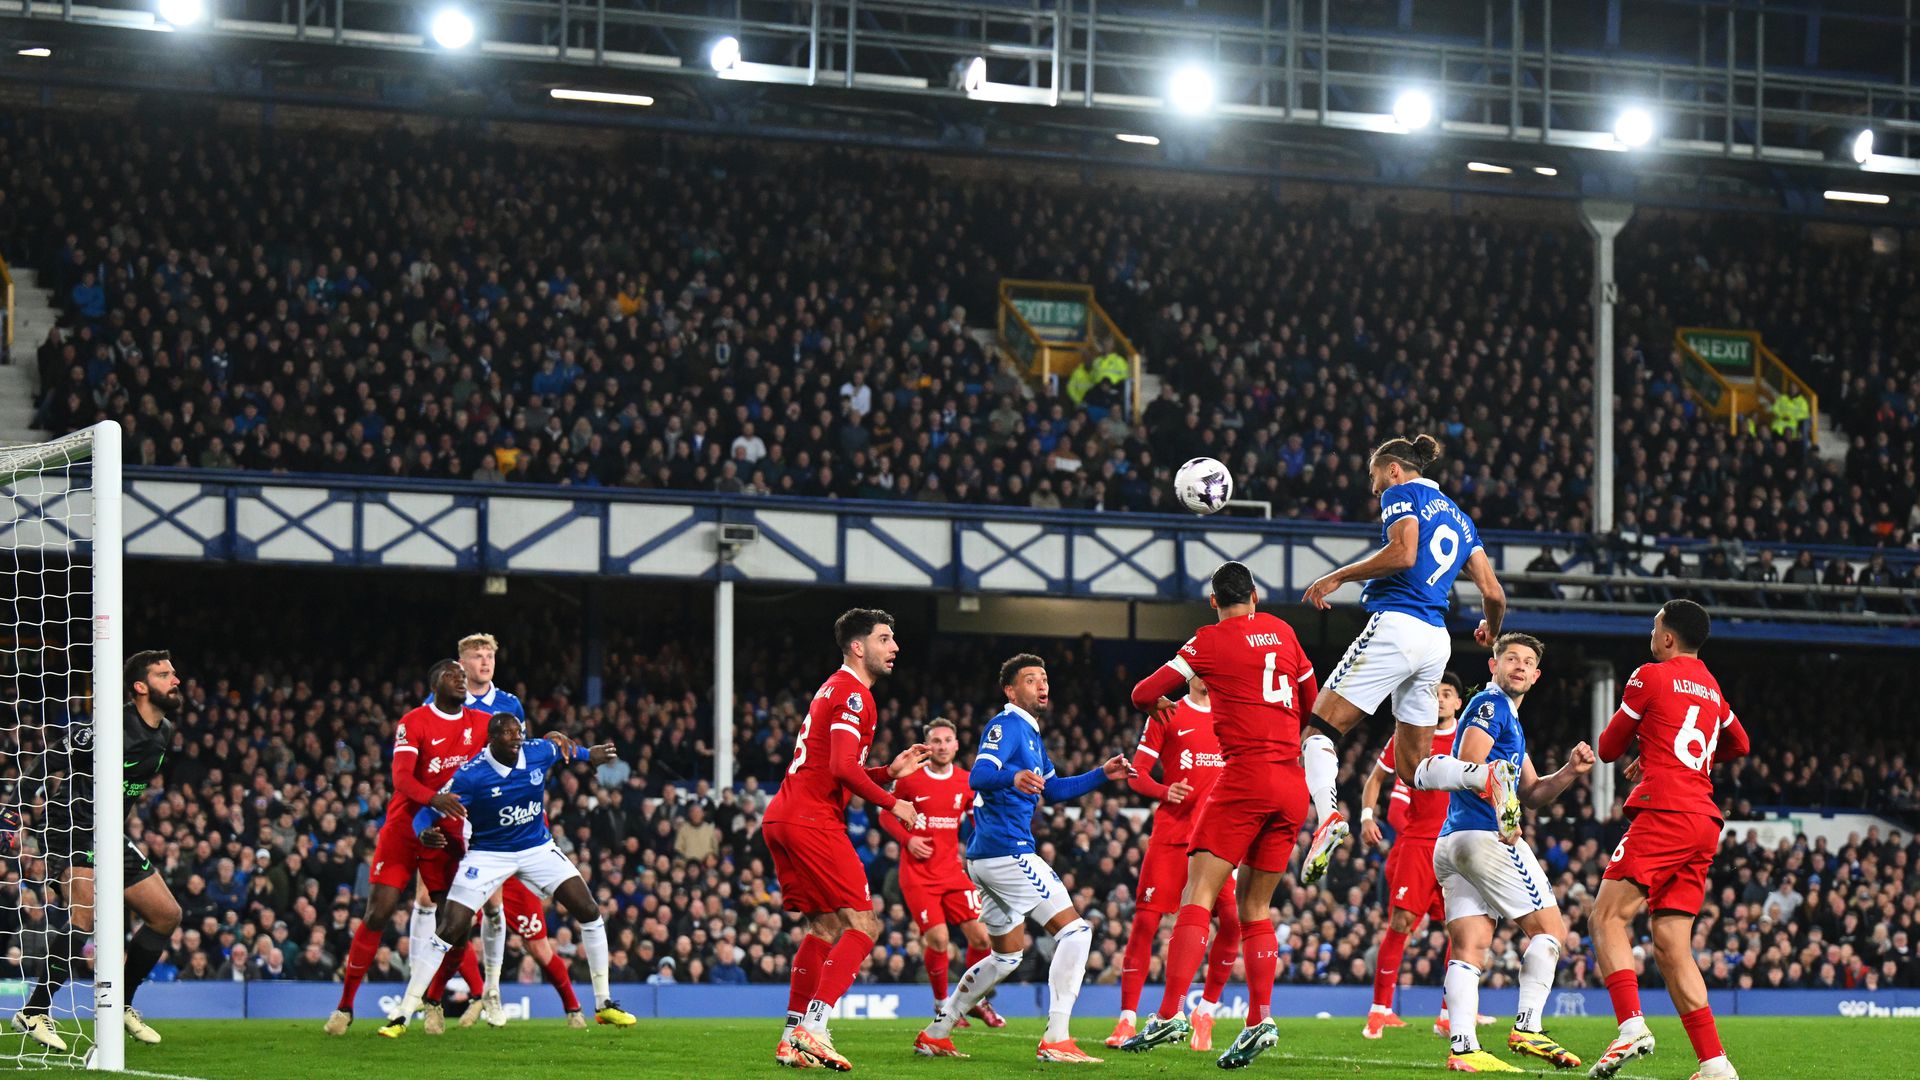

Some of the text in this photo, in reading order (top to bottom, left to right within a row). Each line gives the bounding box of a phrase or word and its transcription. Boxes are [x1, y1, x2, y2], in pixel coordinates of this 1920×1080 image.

[1711, 341, 1750, 360] EXIT
[1420, 498, 1473, 544] CALVERT-LEWIN
[1429, 524, 1459, 587] 9
[1246, 633, 1282, 647] VIRGIL
[1262, 652, 1293, 709] 4
[499, 800, 542, 826] Stake
[515, 815, 534, 826] .com
[964, 889, 983, 910] 10
[517, 912, 543, 934] 26
